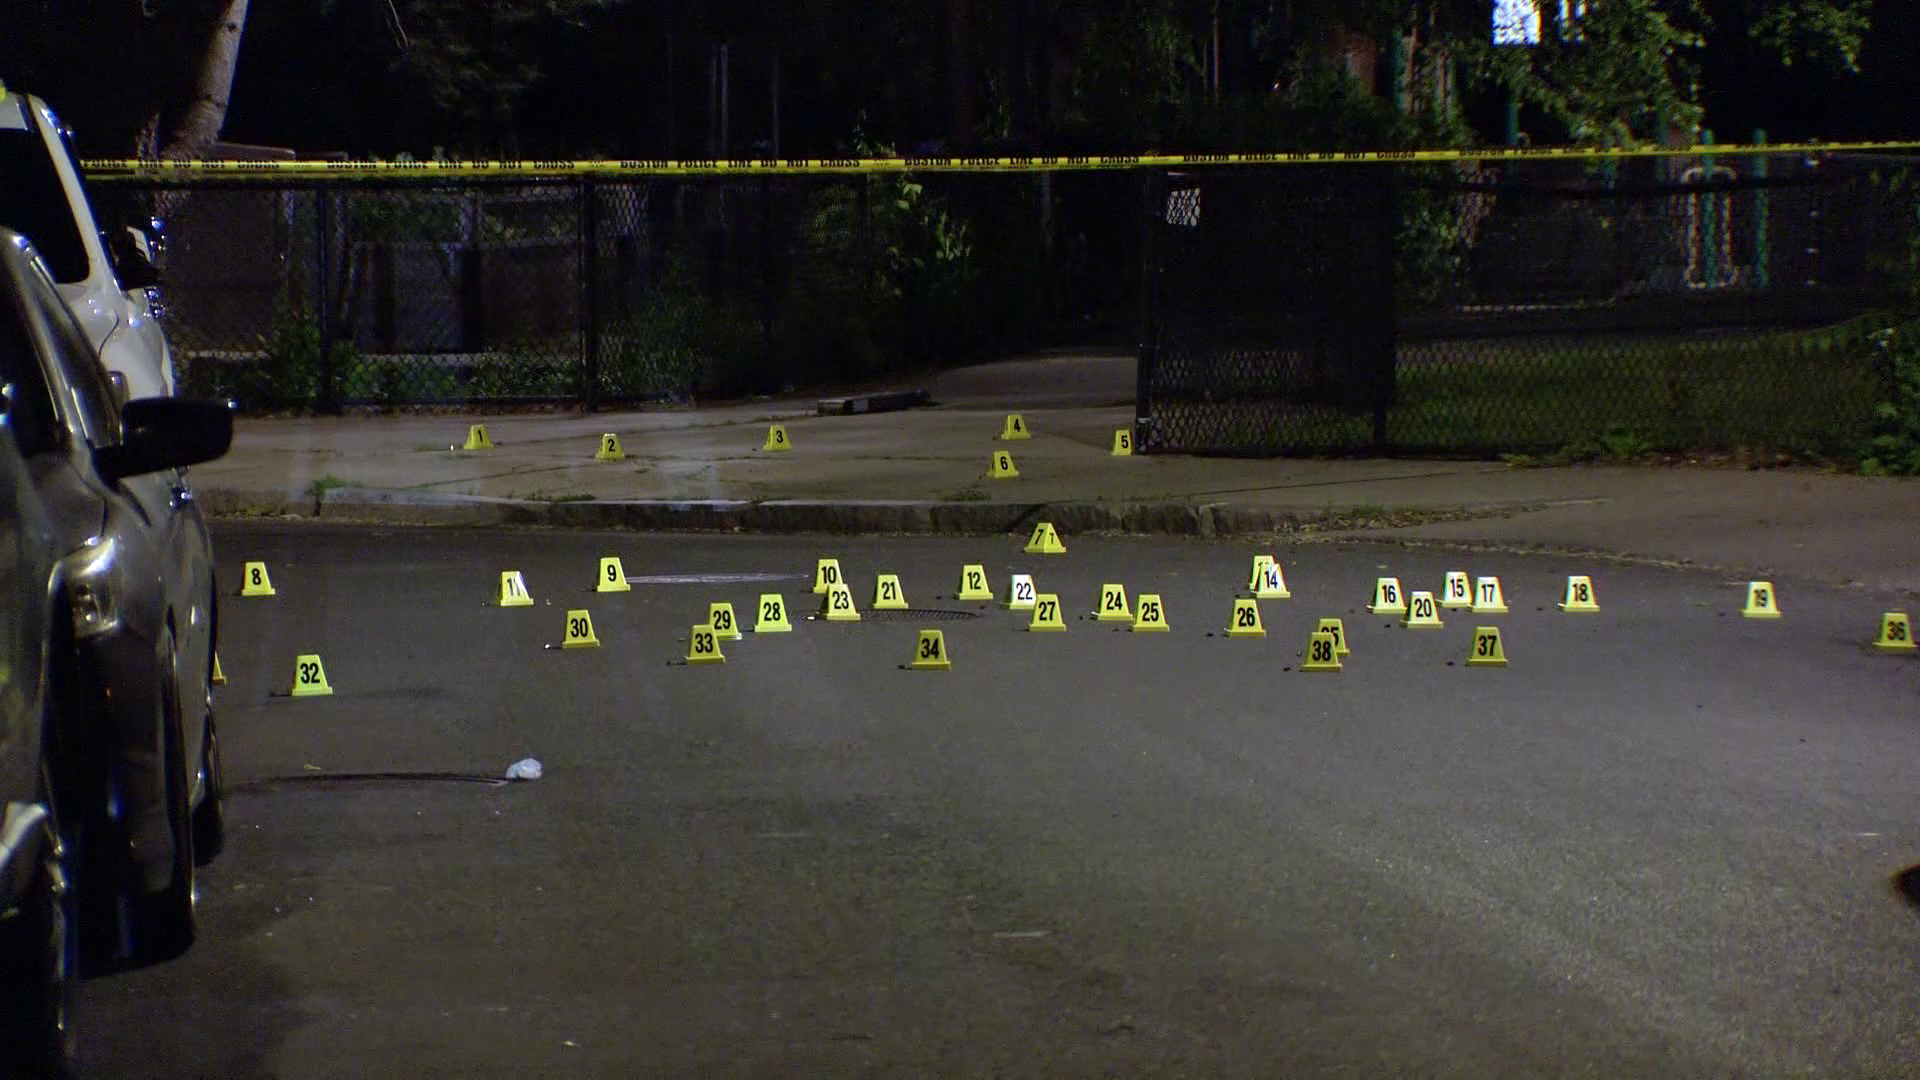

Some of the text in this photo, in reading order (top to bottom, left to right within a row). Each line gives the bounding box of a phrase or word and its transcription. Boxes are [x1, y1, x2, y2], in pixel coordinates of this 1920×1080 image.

[1014, 419, 1020, 432] 4
[477, 430, 483, 442] 1
[608, 439, 615, 451] 2
[776, 431, 783, 443] 3
[1121, 435, 1128, 448] 5
[1001, 457, 1008, 470] 6
[1035, 529, 1044, 544] 7
[252, 568, 261, 585] 8
[607, 565, 616, 581] 9
[822, 566, 836, 584] 10
[968, 572, 981, 589] 12
[1265, 571, 1277, 588] 14
[882, 582, 896, 600] 21
[1017, 583, 1032, 600] 22
[1382, 585, 1396, 603] 16
[1451, 579, 1464, 597] 15
[1481, 584, 1494, 602] 17
[1573, 584, 1588, 602] 18
[833, 591, 849, 609] 23
[1106, 592, 1122, 610] 24
[1415, 599, 1432, 617] 20
[764, 602, 780, 621] 28
[1039, 601, 1055, 619] 27
[1142, 603, 1159, 621] 25
[1237, 607, 1255, 627] 26
[571, 618, 588, 637] 30
[713, 611, 730, 629] 29
[695, 633, 713, 653] 33
[1321, 627, 1339, 646] 5
[1479, 635, 1496, 656] 37
[921, 638, 939, 658] 34
[1312, 641, 1331, 661] 38
[300, 663, 320, 683] 32
